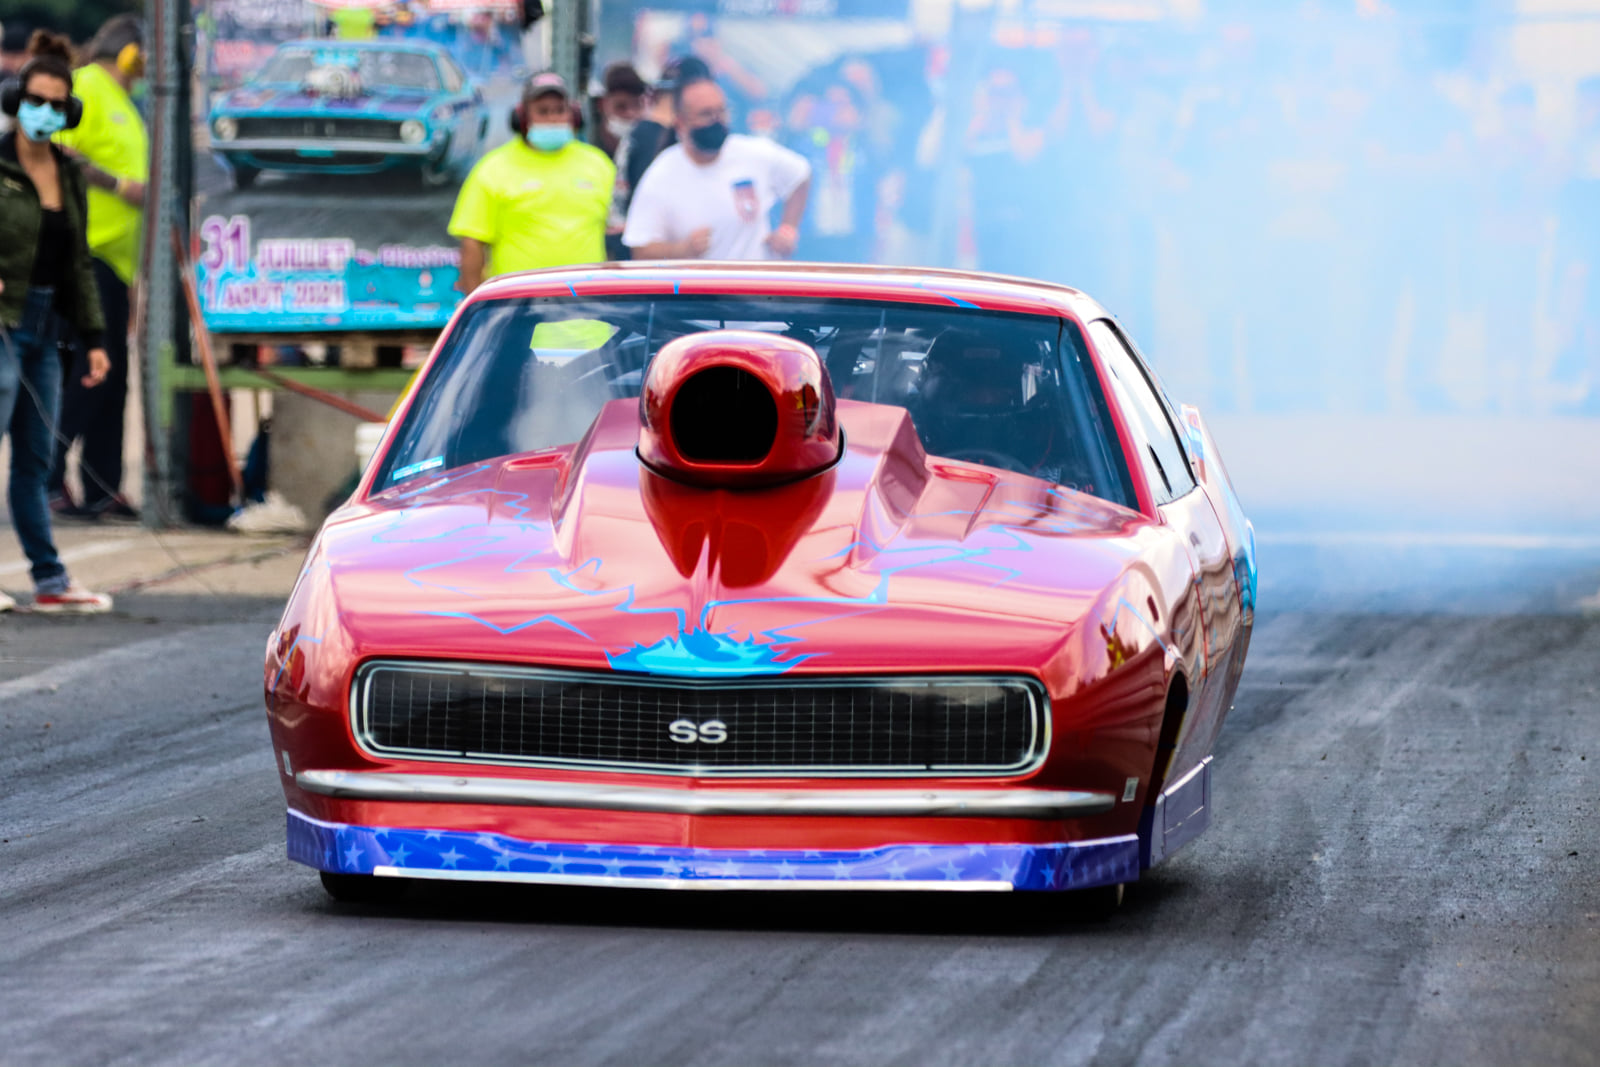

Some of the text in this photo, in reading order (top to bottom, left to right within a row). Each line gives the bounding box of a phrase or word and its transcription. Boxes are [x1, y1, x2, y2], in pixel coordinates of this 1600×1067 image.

[203, 217, 249, 270] 31
[259, 241, 349, 270] JUILLET
[669, 719, 727, 744] SS
